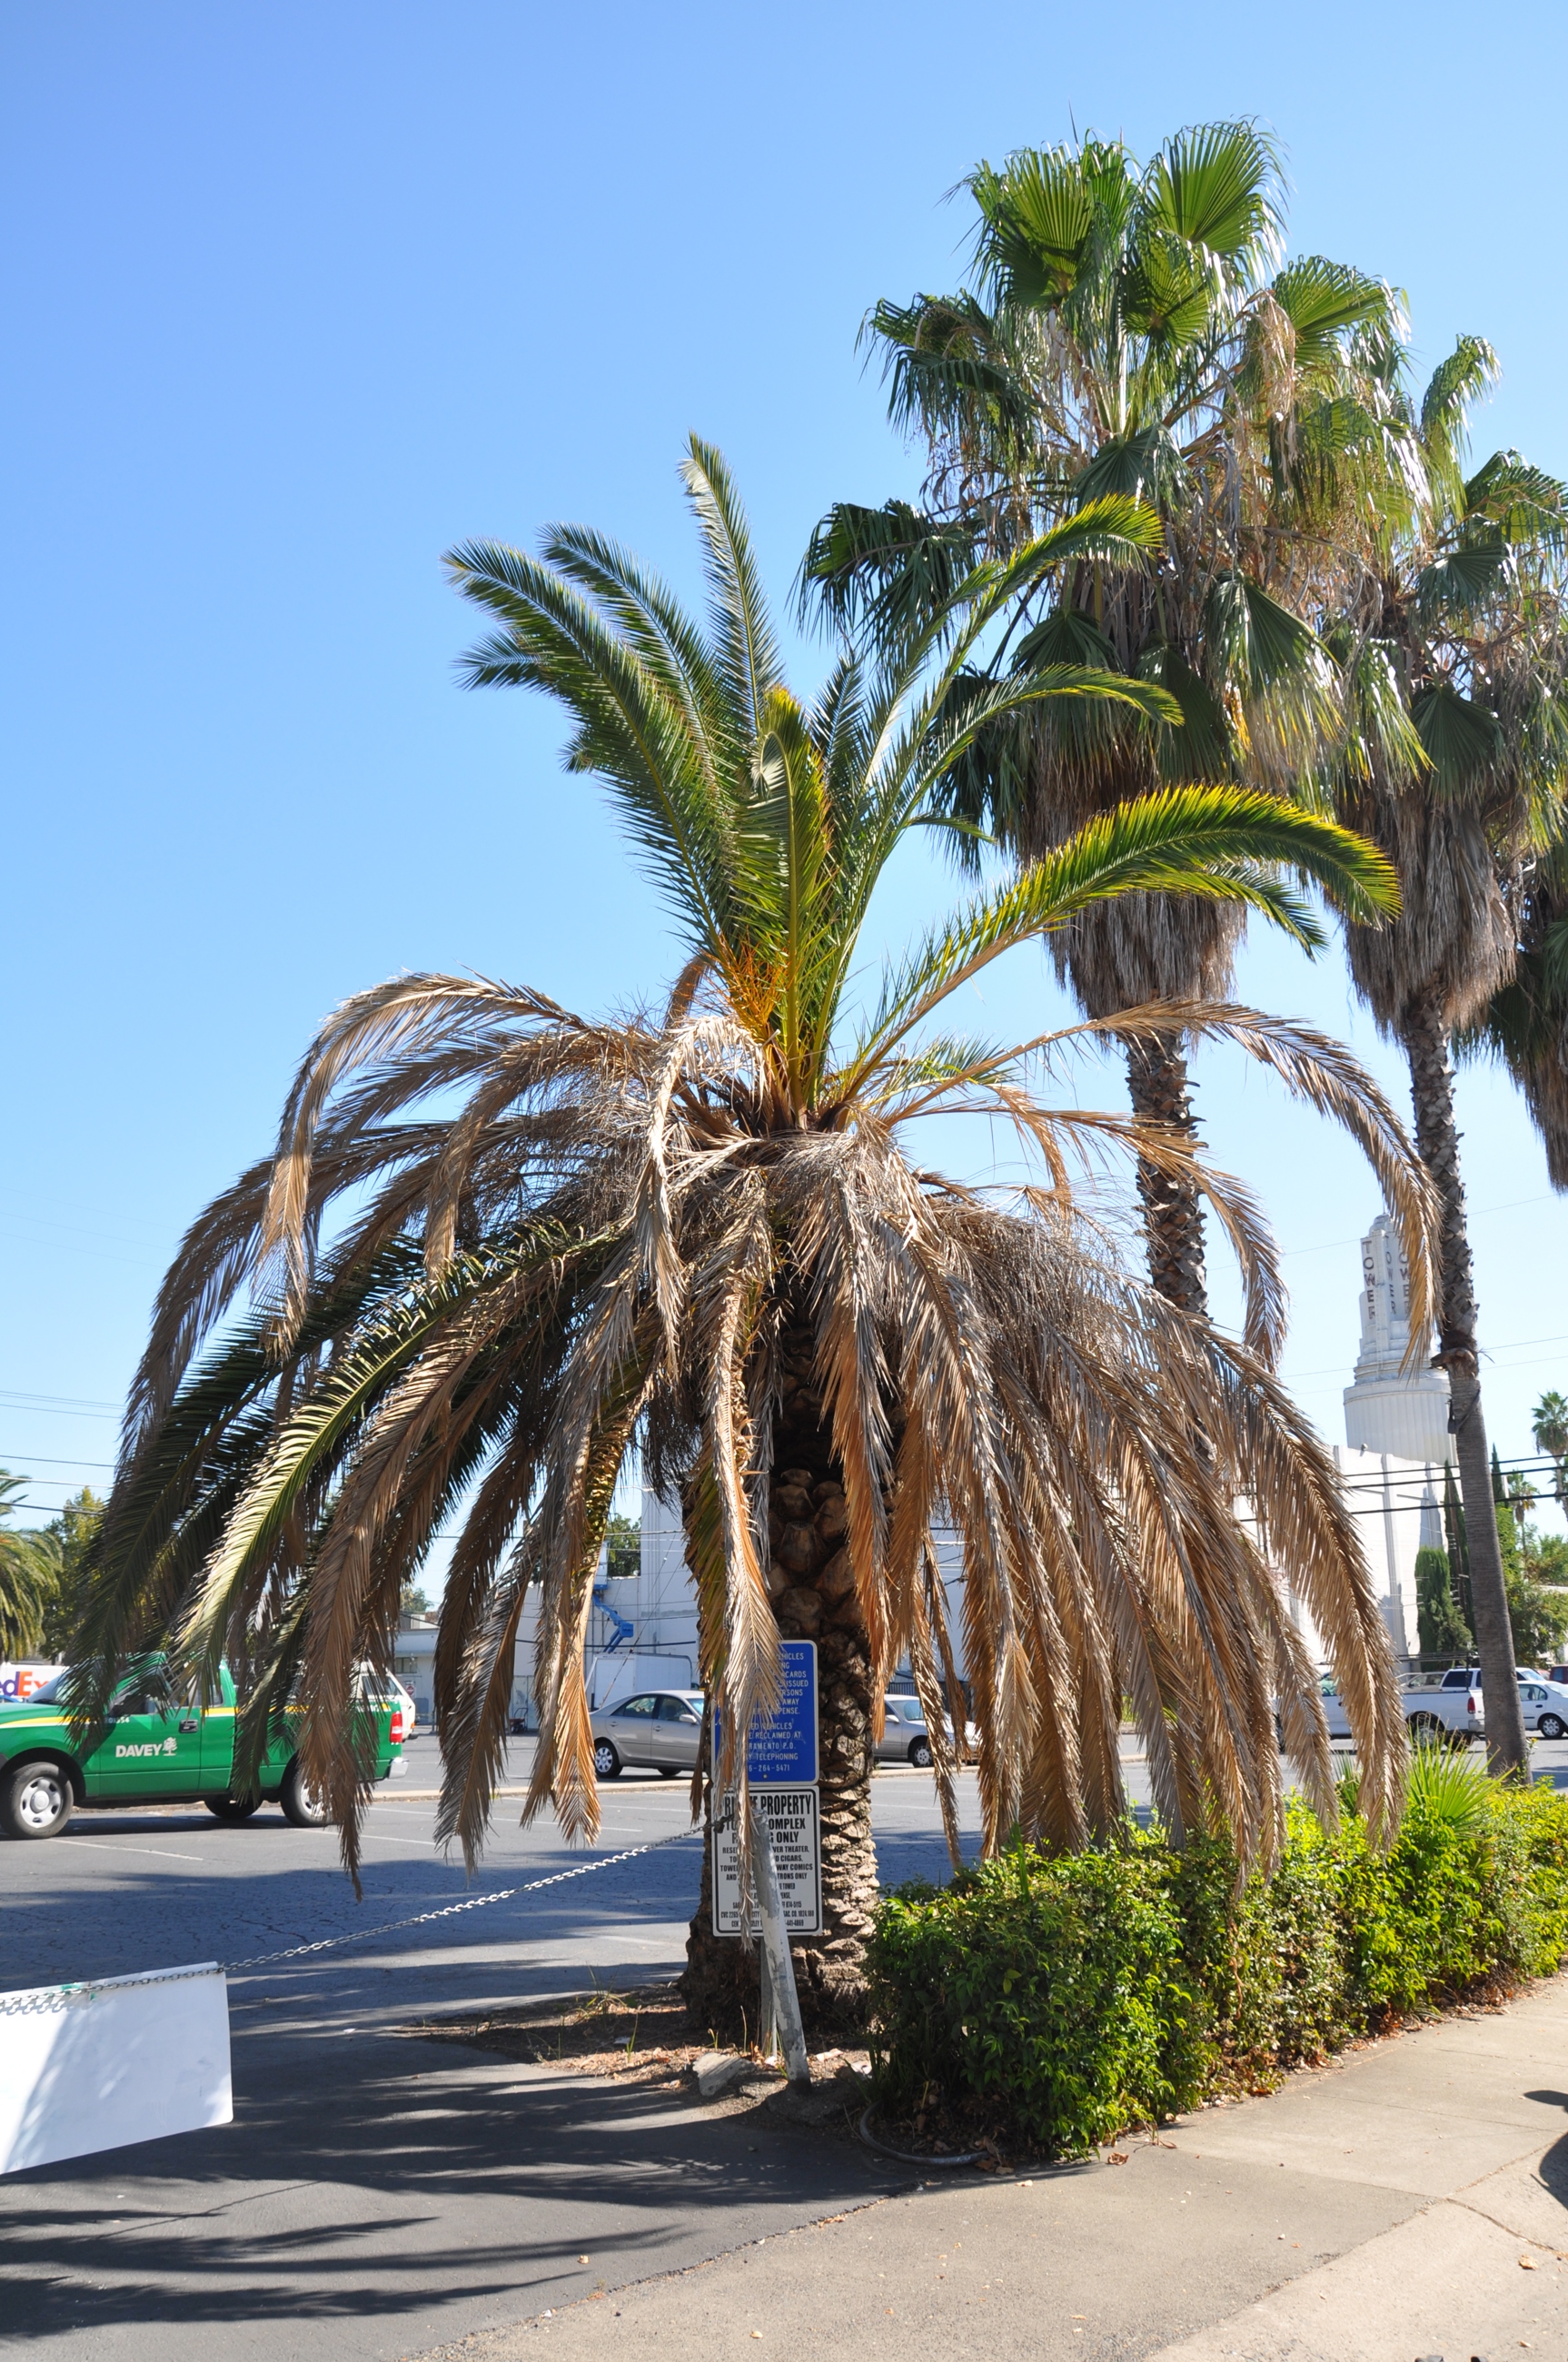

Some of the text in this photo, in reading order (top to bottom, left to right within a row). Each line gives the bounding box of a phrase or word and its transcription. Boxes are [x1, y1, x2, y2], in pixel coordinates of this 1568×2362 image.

[1362, 1240, 1375, 1320] TOWER
[1384, 1236, 1396, 1315] TOWER
[1398, 1236, 1410, 1315] OWER
[777, 1652, 804, 1661] EHICLES
[793, 1731, 801, 1739] AT
[115, 1743, 163, 1758] DAVEY
[756, 1752, 799, 1761] TELEPHONING
[749, 1764, 790, 1772] 6-264-5471
[760, 1794, 811, 1816] PROPERTY
[769, 1818, 806, 1830] OMPLEX
[776, 1831, 799, 1843] ONLY
